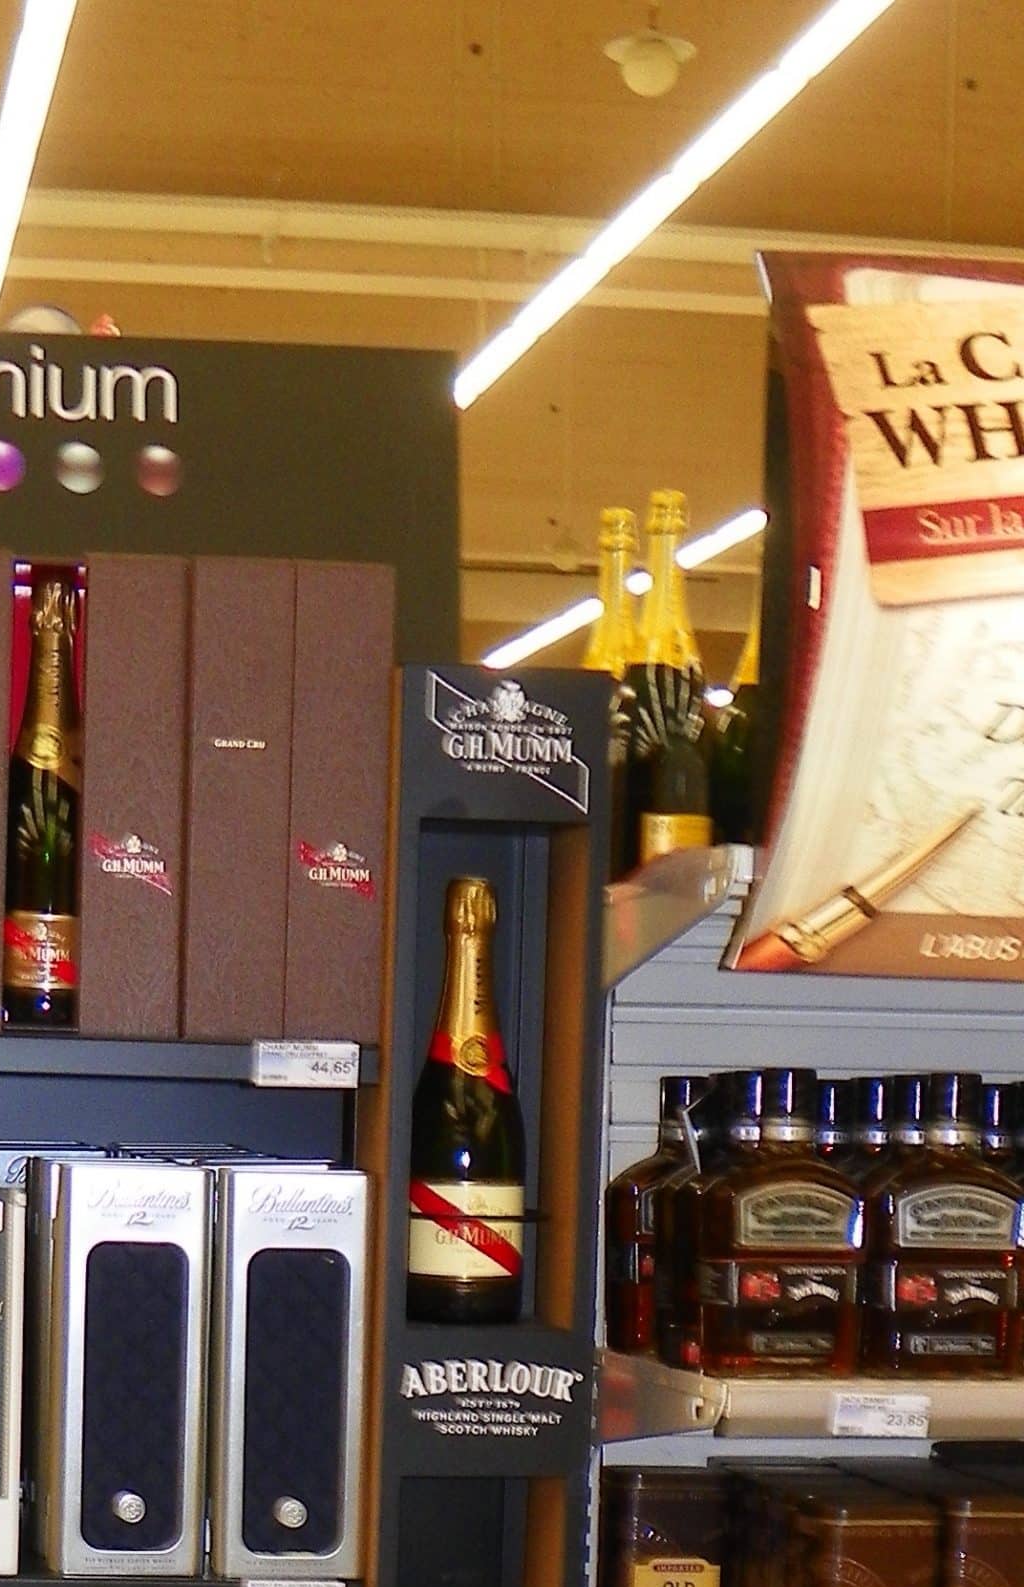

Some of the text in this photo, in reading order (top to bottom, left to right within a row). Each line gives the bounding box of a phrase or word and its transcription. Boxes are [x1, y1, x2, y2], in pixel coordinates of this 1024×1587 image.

[869, 351, 948, 388] La
[918, 507, 981, 545] Sur
[214, 737, 266, 750] GRAND CRU
[125, 1211, 152, 1226] 12
[287, 1215, 312, 1231] 12
[402, 1360, 574, 1403] ABERLOUR
[417, 1411, 562, 1425] HIGHLAND SINGLE MALT
[439, 1424, 539, 1437] SCOTCH WHISKY
